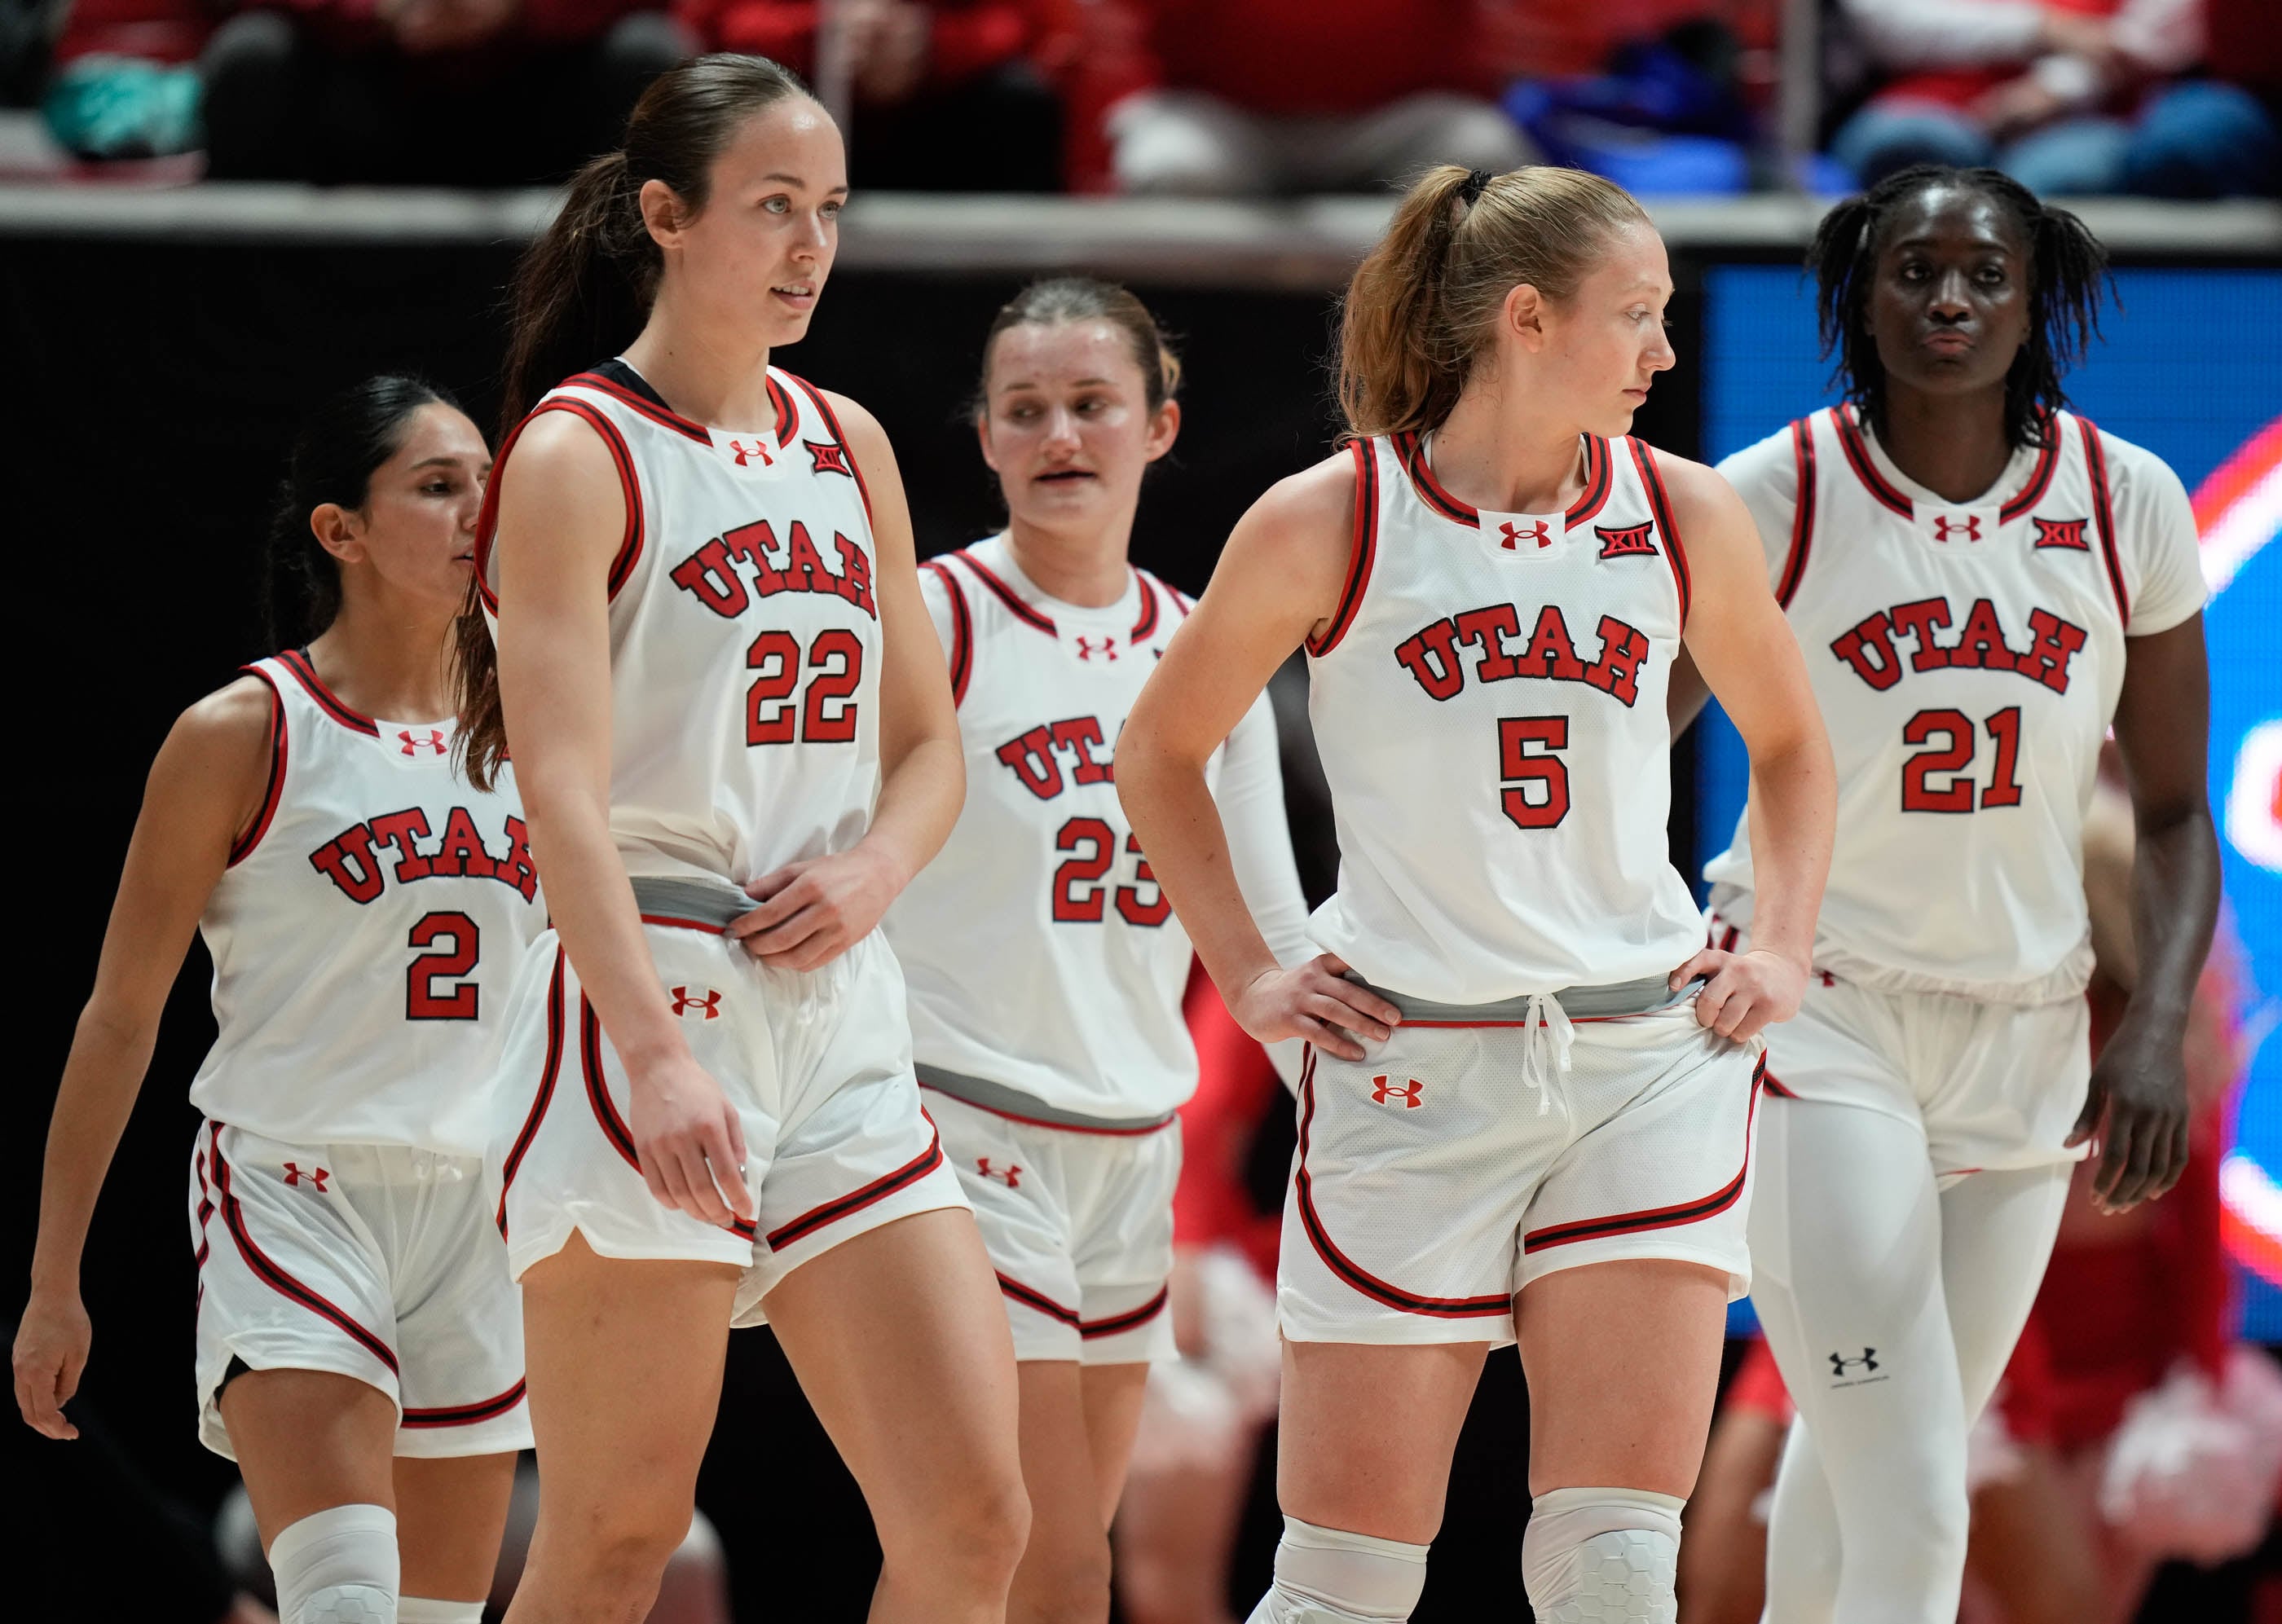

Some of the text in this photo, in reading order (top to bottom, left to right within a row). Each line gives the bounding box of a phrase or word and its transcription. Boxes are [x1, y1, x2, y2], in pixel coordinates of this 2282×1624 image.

[669, 519, 877, 621] UTAH
[1596, 522, 1658, 559] XII
[2034, 518, 2089, 551] XII
[746, 629, 863, 747] 22
[1394, 602, 1650, 708] UTAH
[1830, 596, 2088, 696] UTAH
[995, 715, 1125, 800] UT
[1497, 715, 1571, 830] 5
[1901, 706, 2023, 813] 21
[406, 911, 480, 1020] 2
